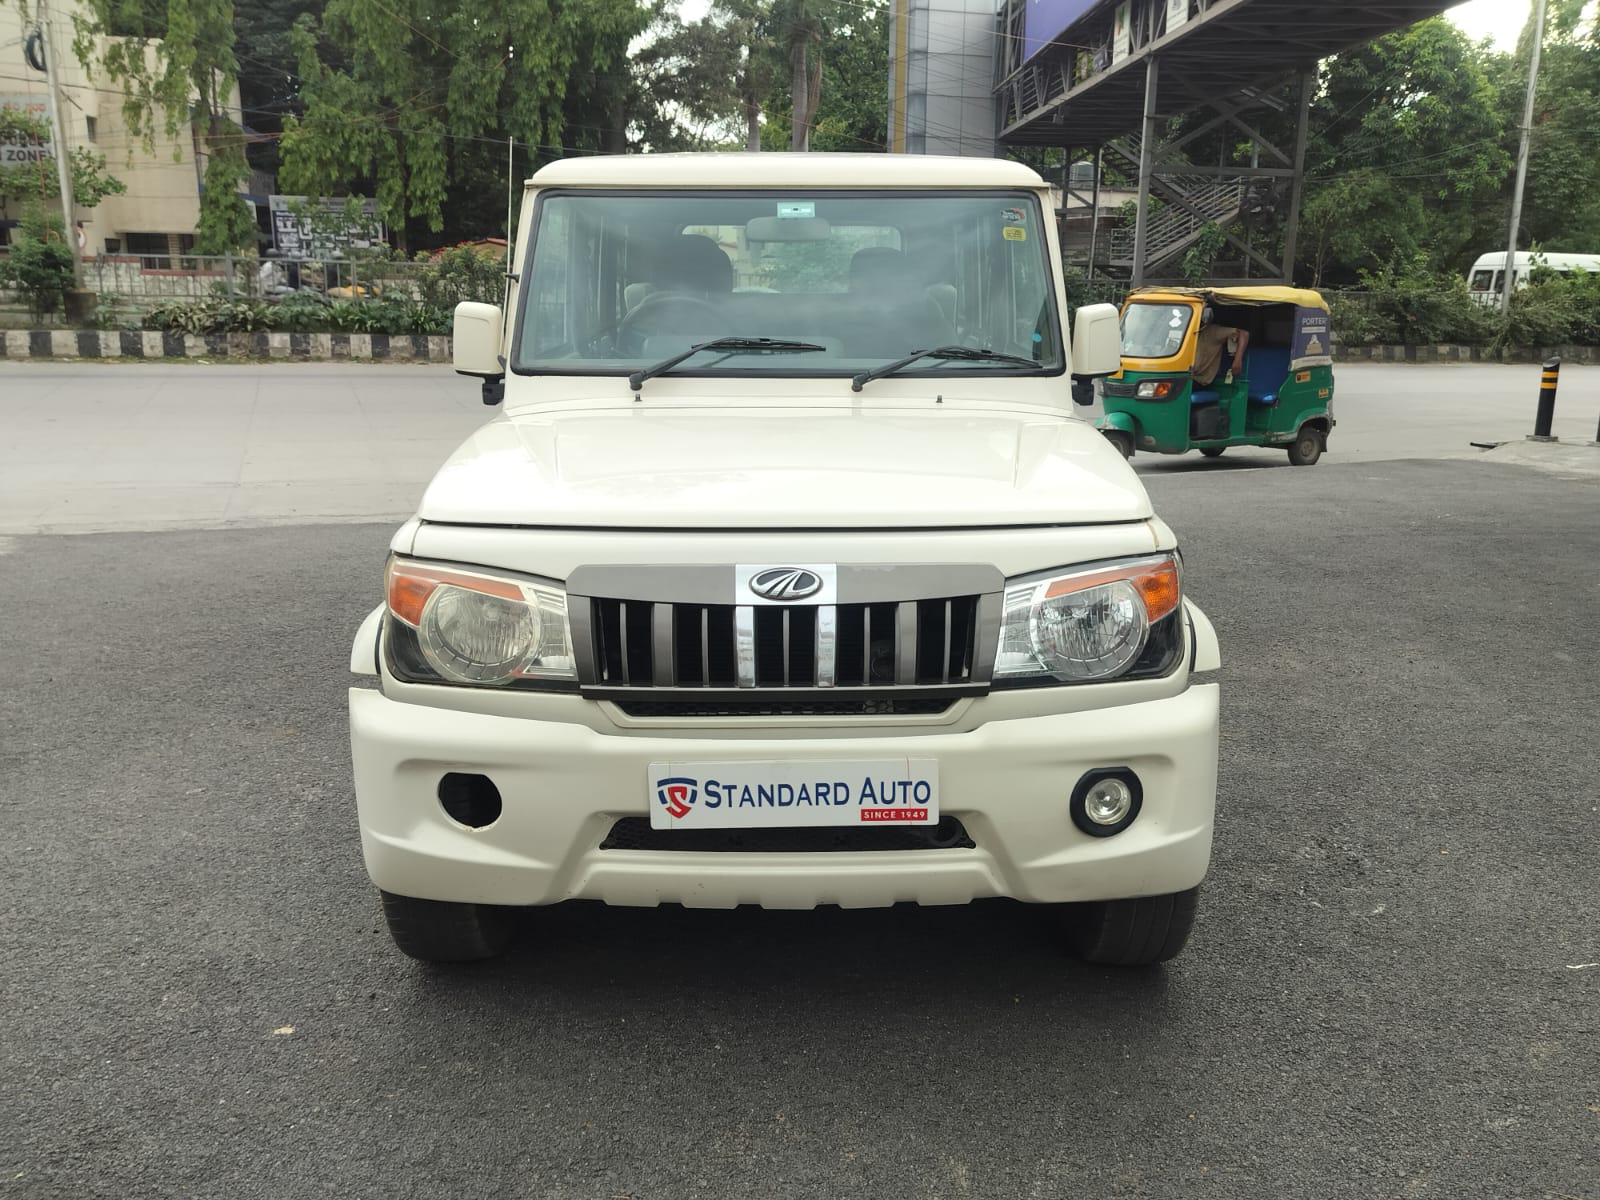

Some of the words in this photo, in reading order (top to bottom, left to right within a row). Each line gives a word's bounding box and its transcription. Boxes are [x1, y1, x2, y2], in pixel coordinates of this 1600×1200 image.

[6, 149, 47, 161] ZONE
[704, 779, 850, 809] STANDARD
[858, 777, 931, 805] AUTO
[863, 811, 897, 820] SINCE
[900, 810, 926, 819] 1949
